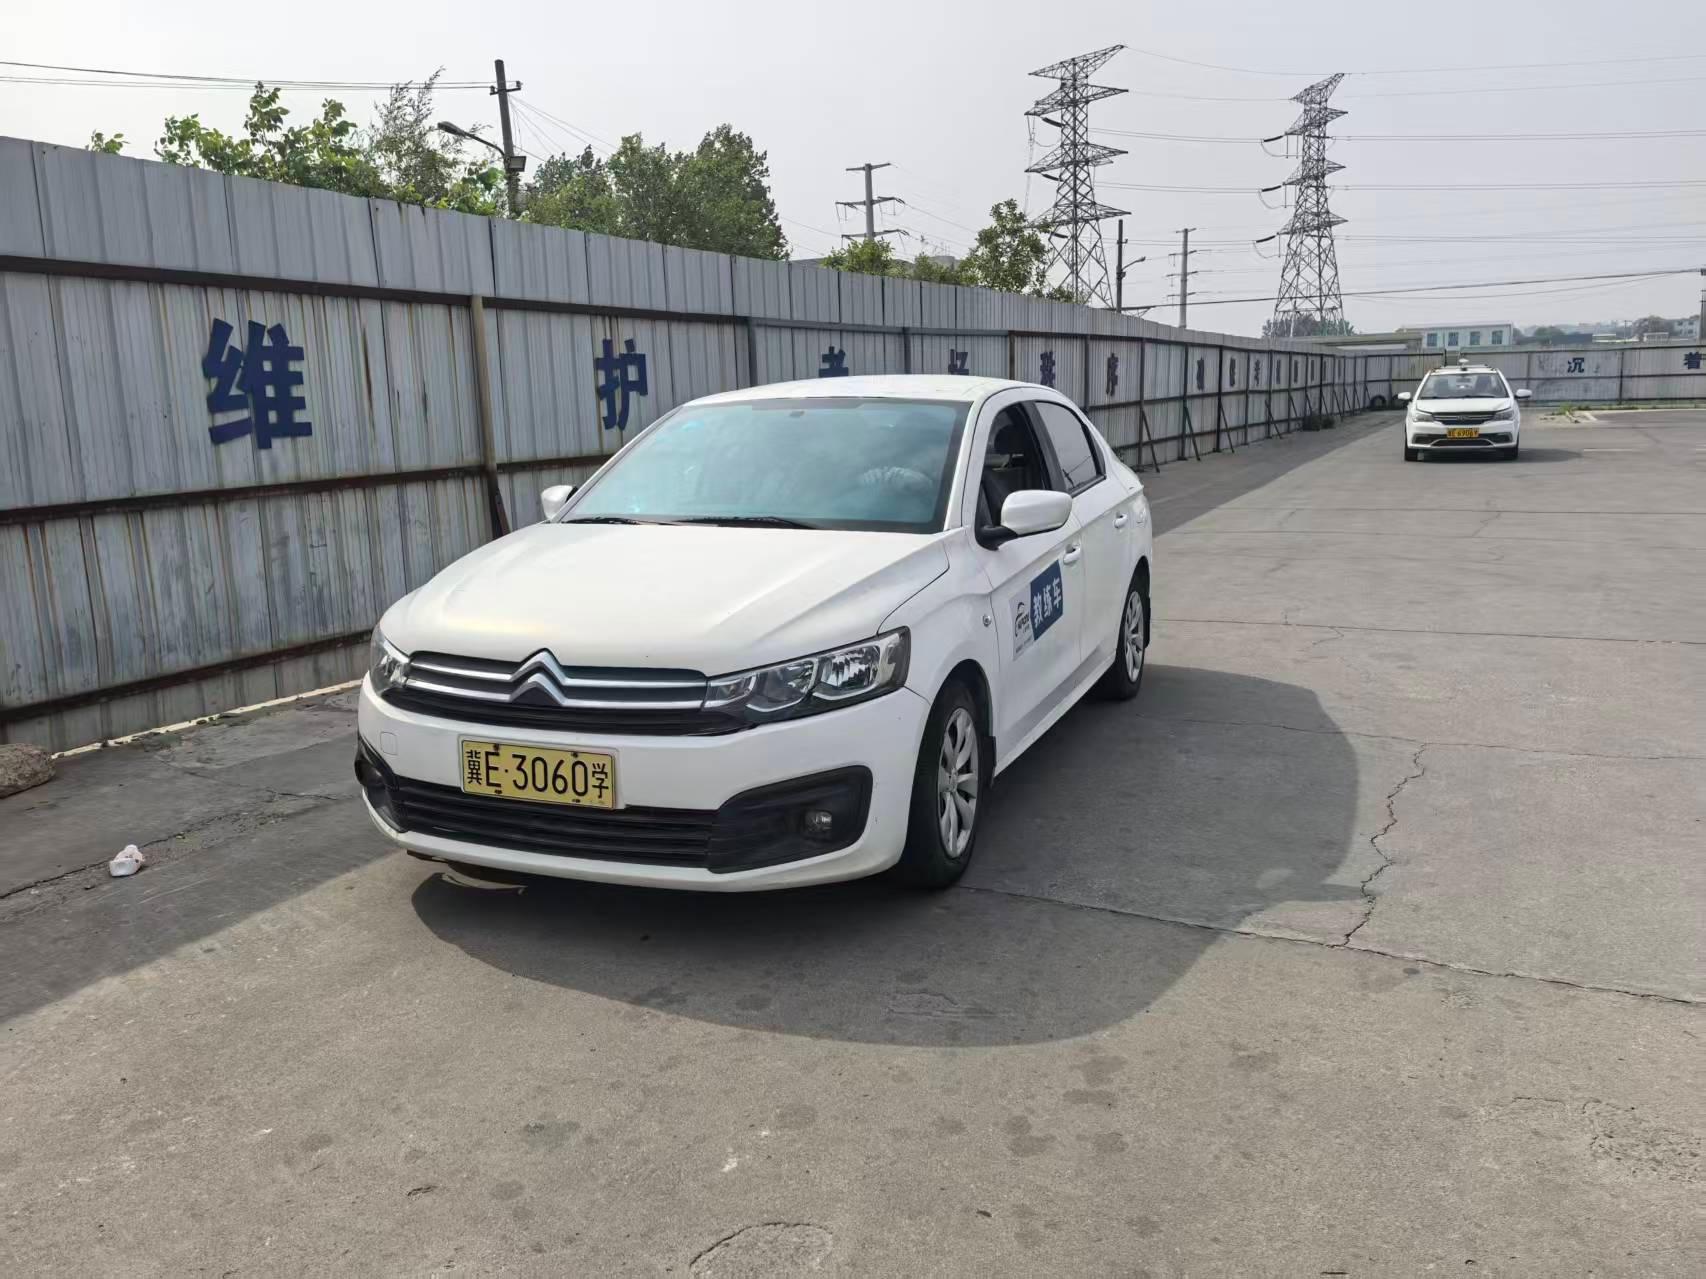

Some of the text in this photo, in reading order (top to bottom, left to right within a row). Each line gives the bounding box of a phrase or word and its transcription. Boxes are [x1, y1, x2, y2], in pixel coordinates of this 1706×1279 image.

[201, 317, 313, 449] 维
[595, 338, 648, 431] 护
[1567, 357, 1585, 373] 沉
[1033, 577, 1062, 629] 教练车
